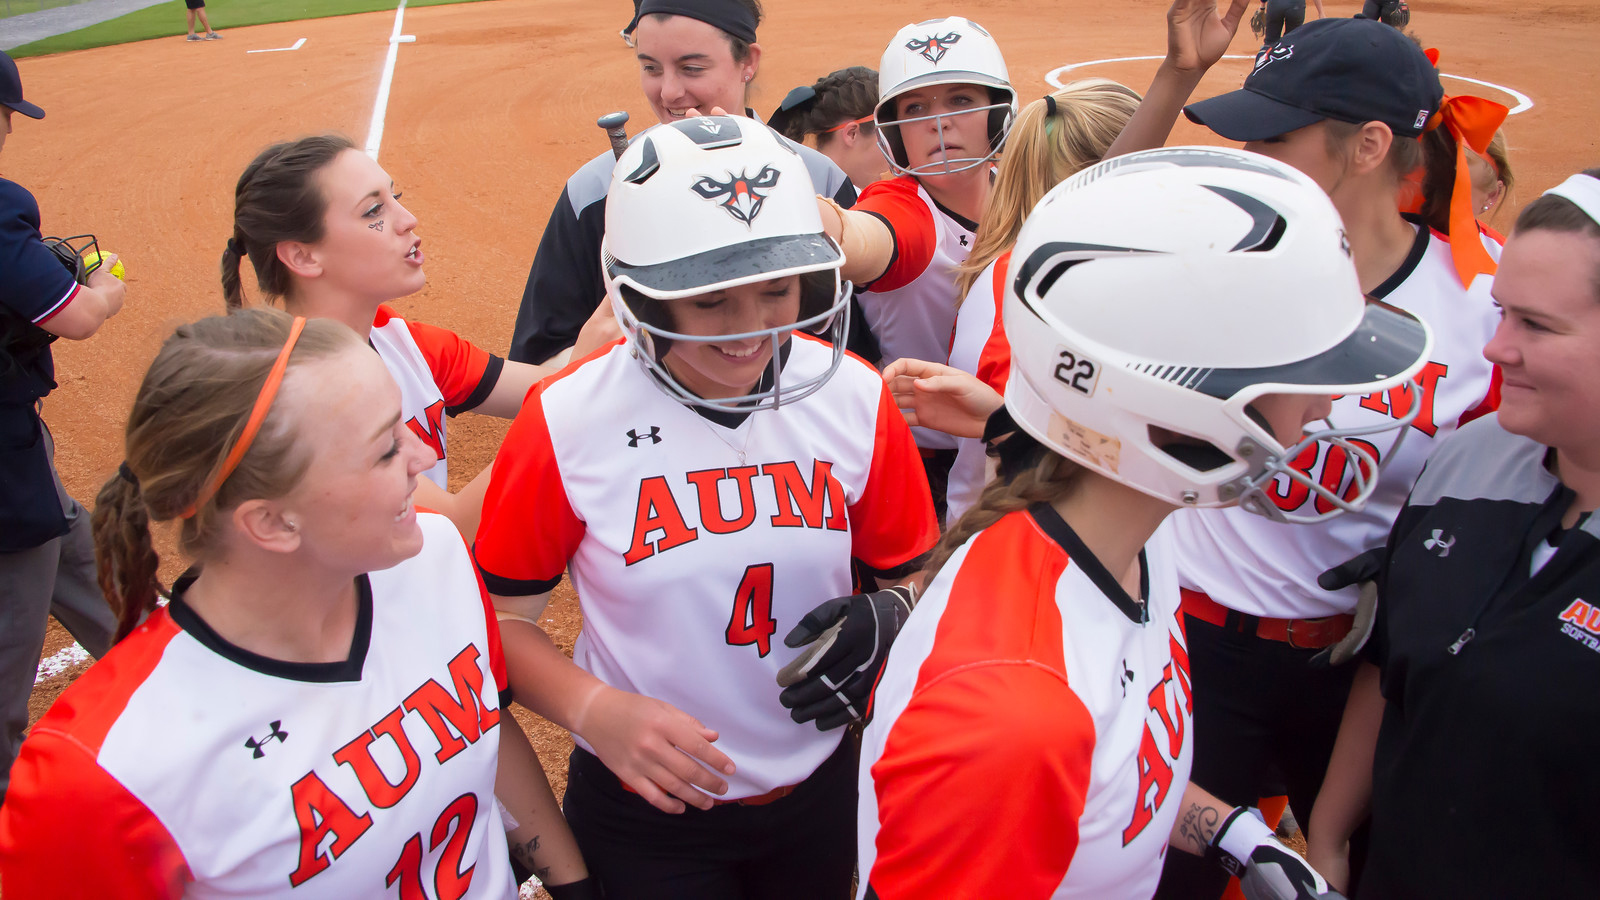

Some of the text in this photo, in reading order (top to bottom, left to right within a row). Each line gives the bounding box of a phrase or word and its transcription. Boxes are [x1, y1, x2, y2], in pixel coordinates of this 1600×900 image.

[1054, 350, 1095, 394] 22
[623, 458, 849, 566] AUM
[1265, 434, 1381, 515] 30
[725, 562, 777, 658] 4
[288, 642, 501, 888] AUM
[385, 791, 478, 900] 12
